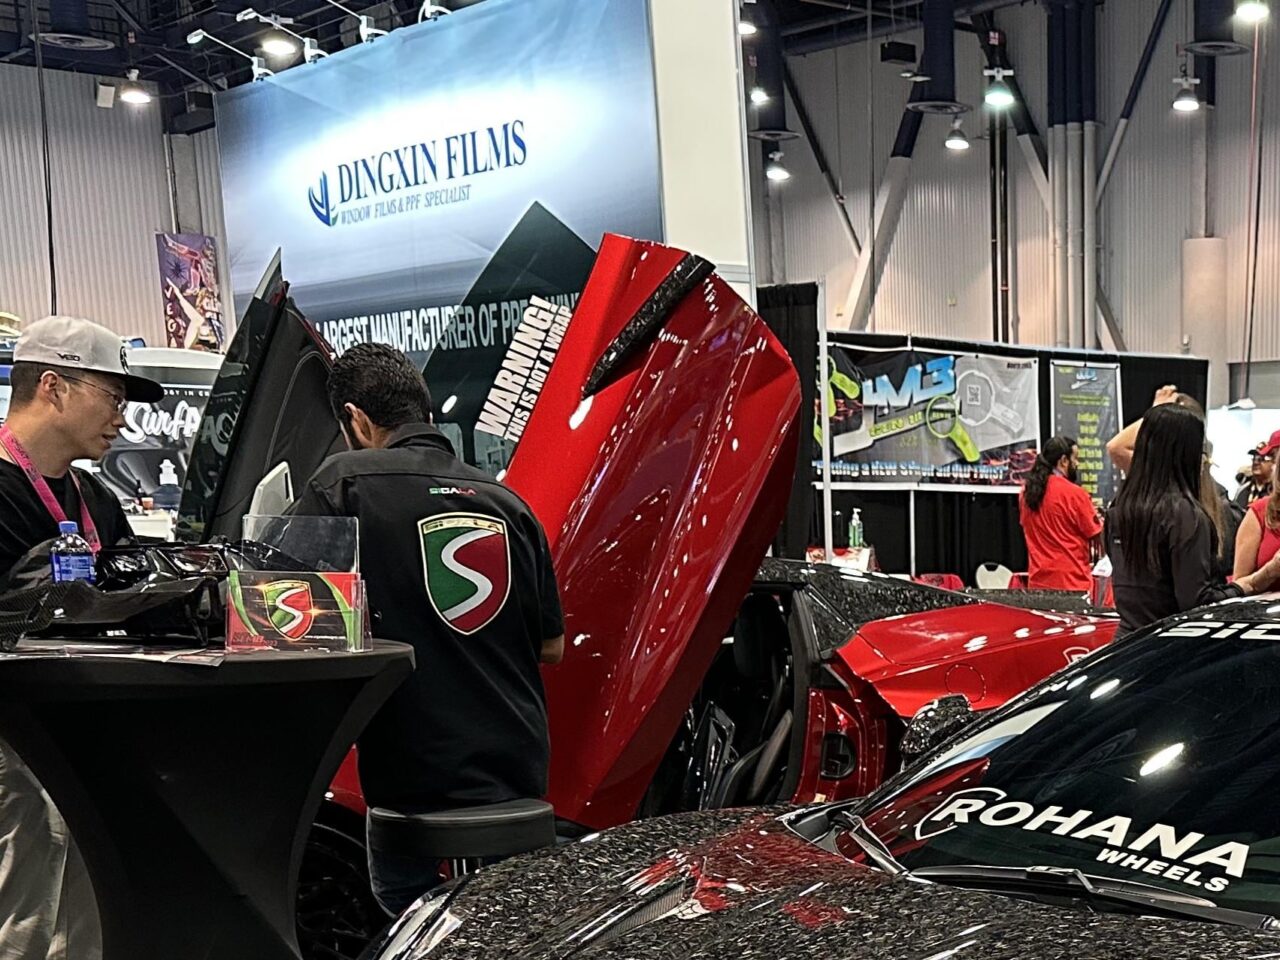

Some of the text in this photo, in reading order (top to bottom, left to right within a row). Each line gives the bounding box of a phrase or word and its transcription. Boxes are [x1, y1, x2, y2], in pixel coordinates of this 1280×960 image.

[338, 119, 527, 204] DINGXIN FILMS
[341, 206, 372, 225] WINDOW
[374, 200, 397, 219] FILMS
[405, 193, 420, 212] PPF
[424, 185, 471, 208] SPECIALIST
[369, 304, 478, 353] MANUFACTURER
[478, 303, 498, 347] OF
[543, 305, 573, 350] WRAP
[474, 294, 559, 437] WARNING!
[526, 360, 550, 393] NOT
[539, 349, 556, 363] A
[519, 391, 538, 410] IS
[504, 408, 531, 442] THIS
[930, 797, 1250, 878] ROHANA
[1096, 848, 1229, 893] WHEELS
